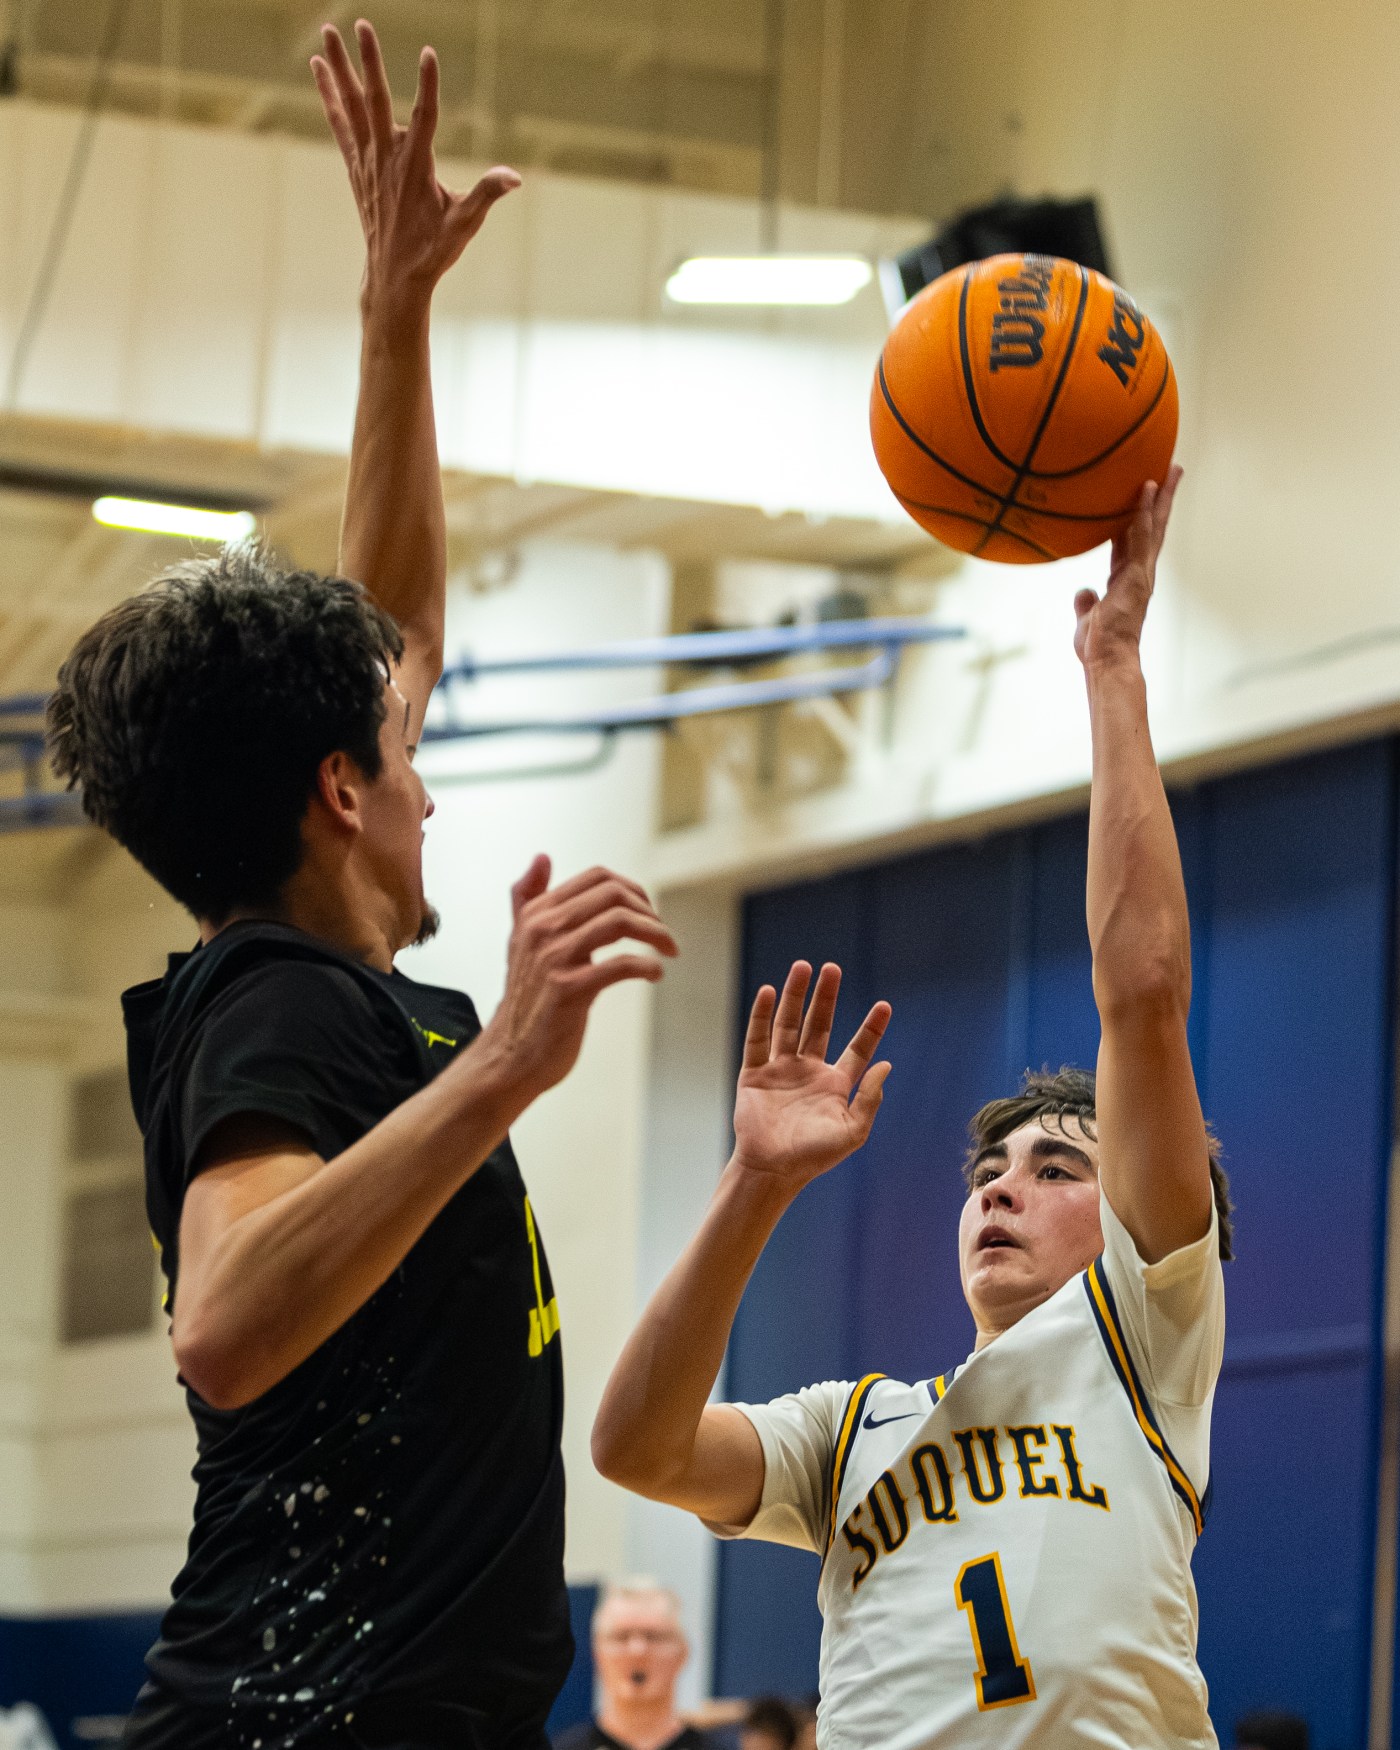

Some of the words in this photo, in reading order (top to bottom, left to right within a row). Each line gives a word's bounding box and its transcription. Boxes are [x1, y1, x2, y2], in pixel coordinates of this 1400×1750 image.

[1097, 285, 1145, 389] NC
[843, 1424, 1110, 1592] SOQUEL
[954, 1551, 1037, 1712] 1
